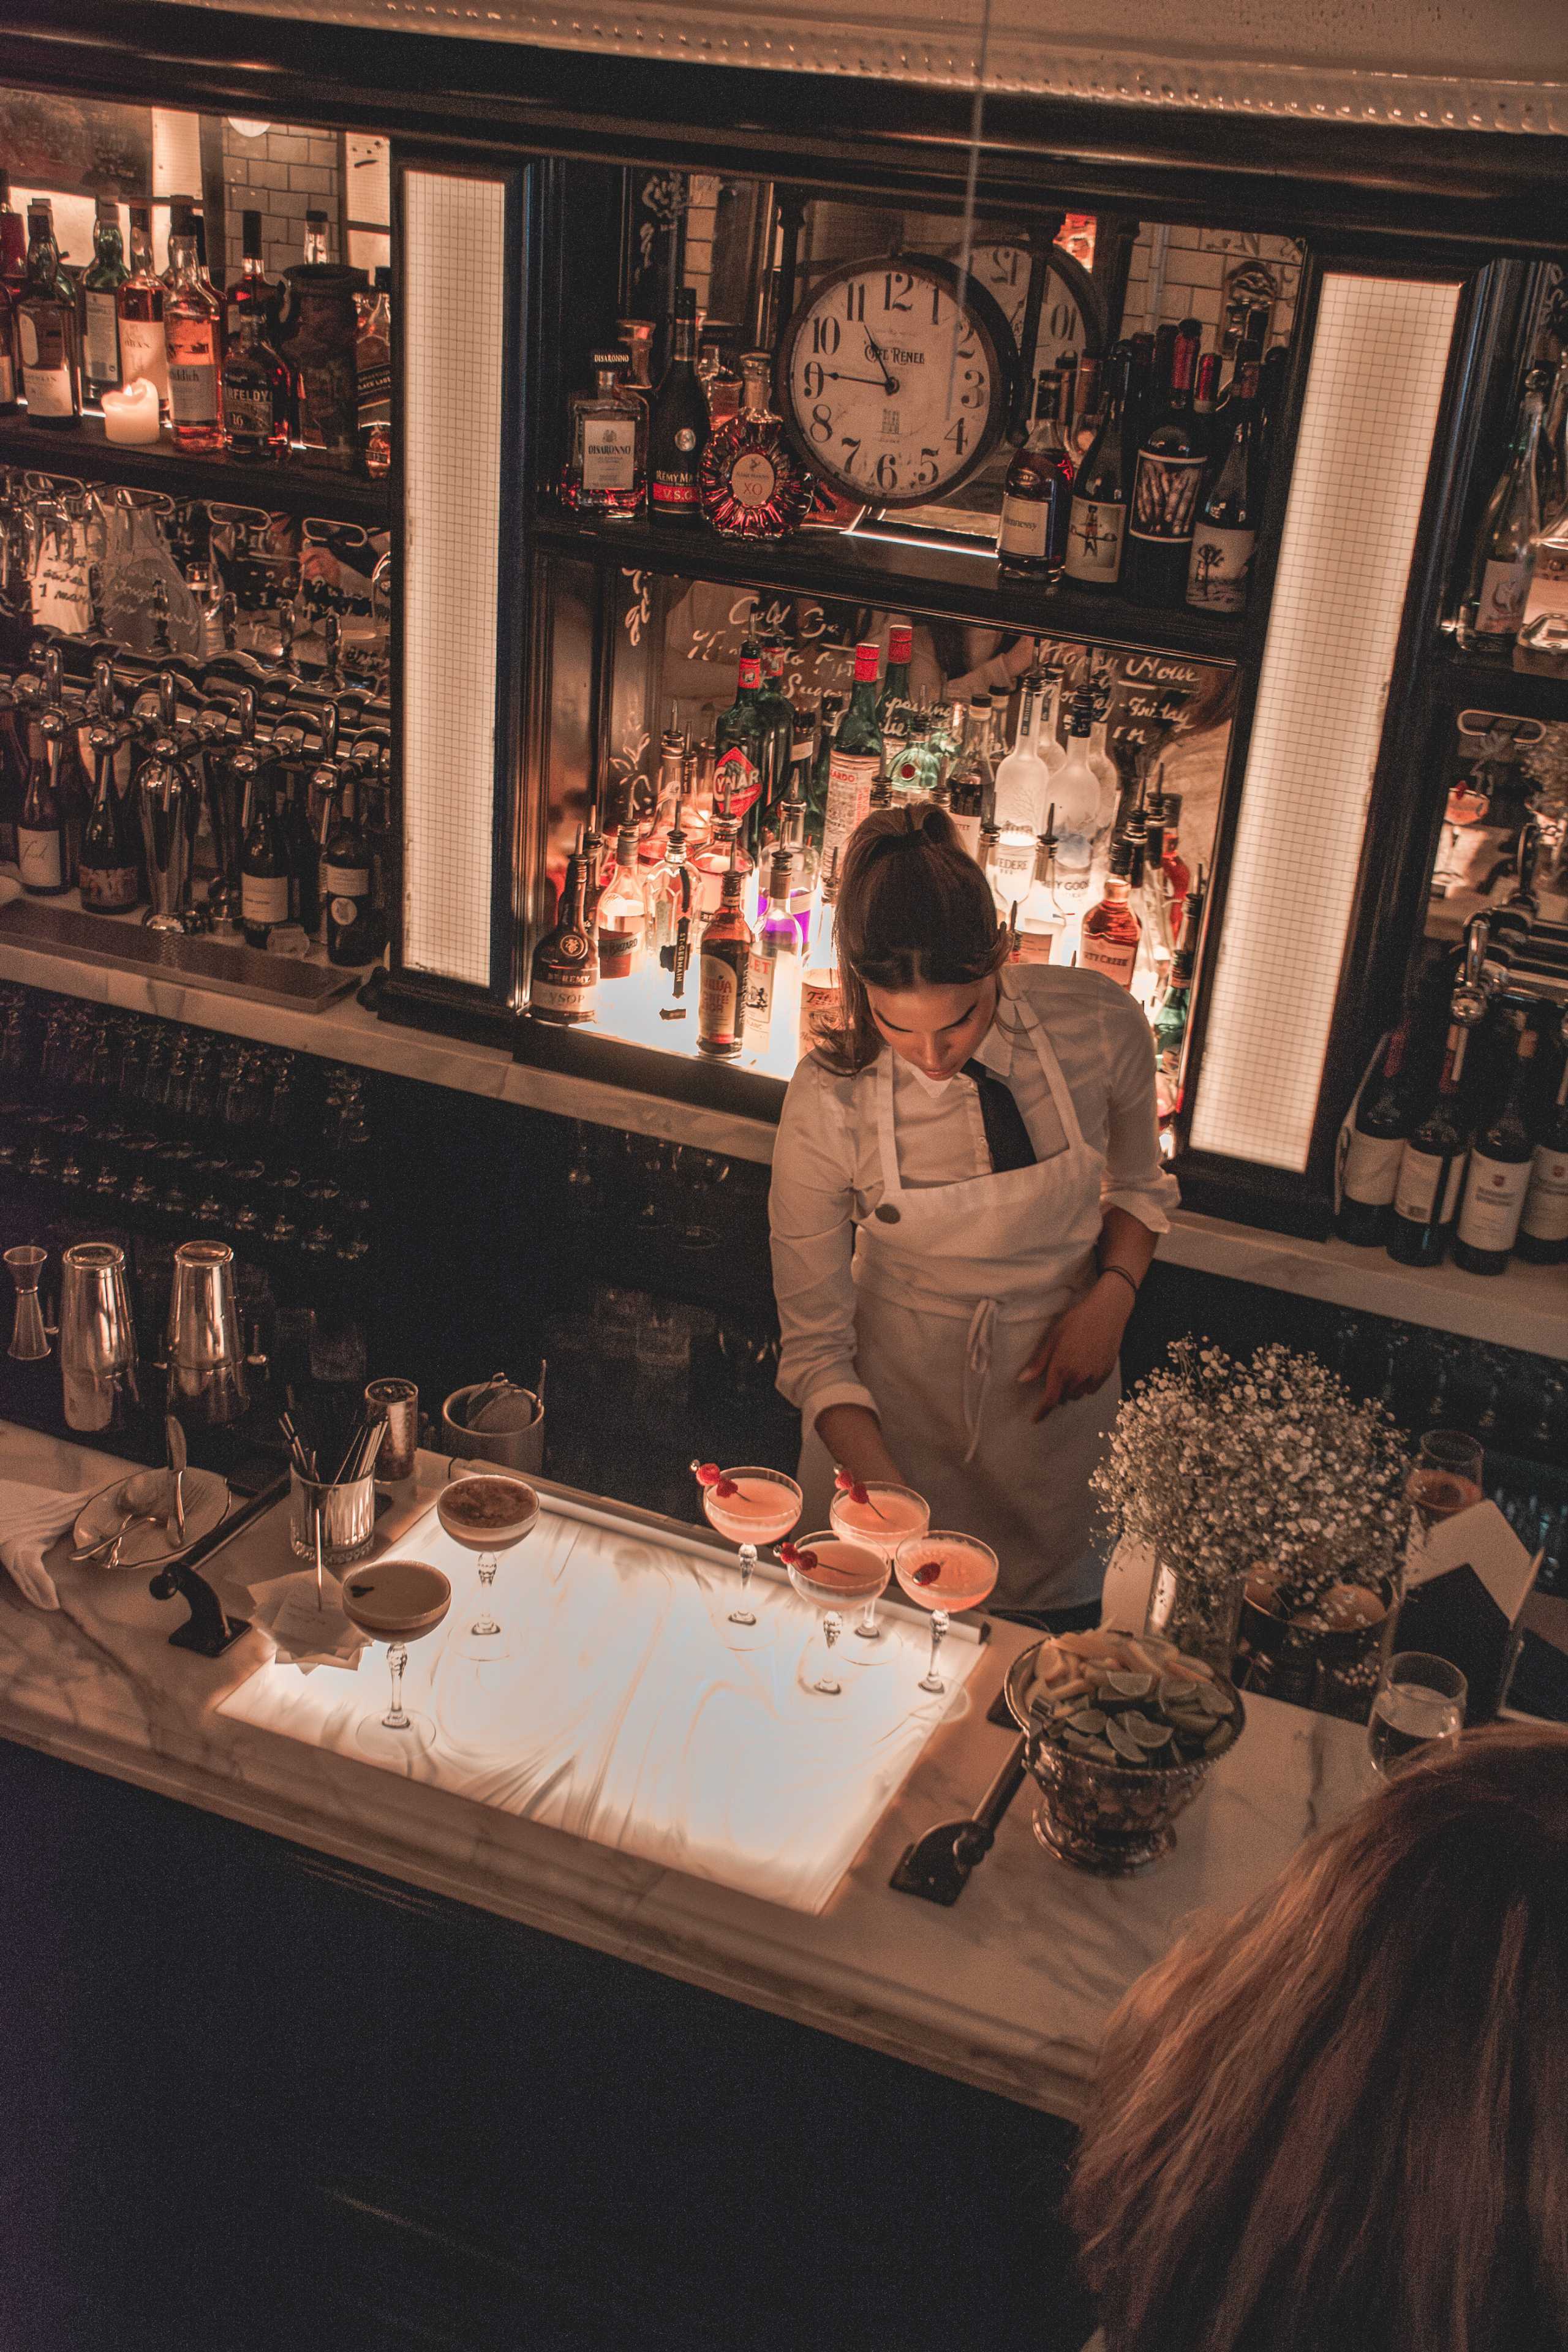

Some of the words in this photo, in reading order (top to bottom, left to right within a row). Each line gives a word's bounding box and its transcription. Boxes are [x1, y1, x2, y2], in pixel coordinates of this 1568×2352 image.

[846, 283, 865, 322] 11
[883, 273, 913, 311] 12
[932, 287, 940, 325] 1
[813, 316, 841, 355] 10
[594, 354, 629, 363] DISARONNO
[804, 361, 824, 399] 9
[960, 370, 984, 409] 3
[810, 404, 833, 443] 8
[944, 417, 968, 456] 4
[588, 445, 631, 455] DISARONNO
[842, 437, 861, 474] 7
[918, 448, 940, 486] 5
[743, 482, 763, 496] XO
[876, 453, 898, 491] 6
[713, 766, 760, 802] CYNAR
